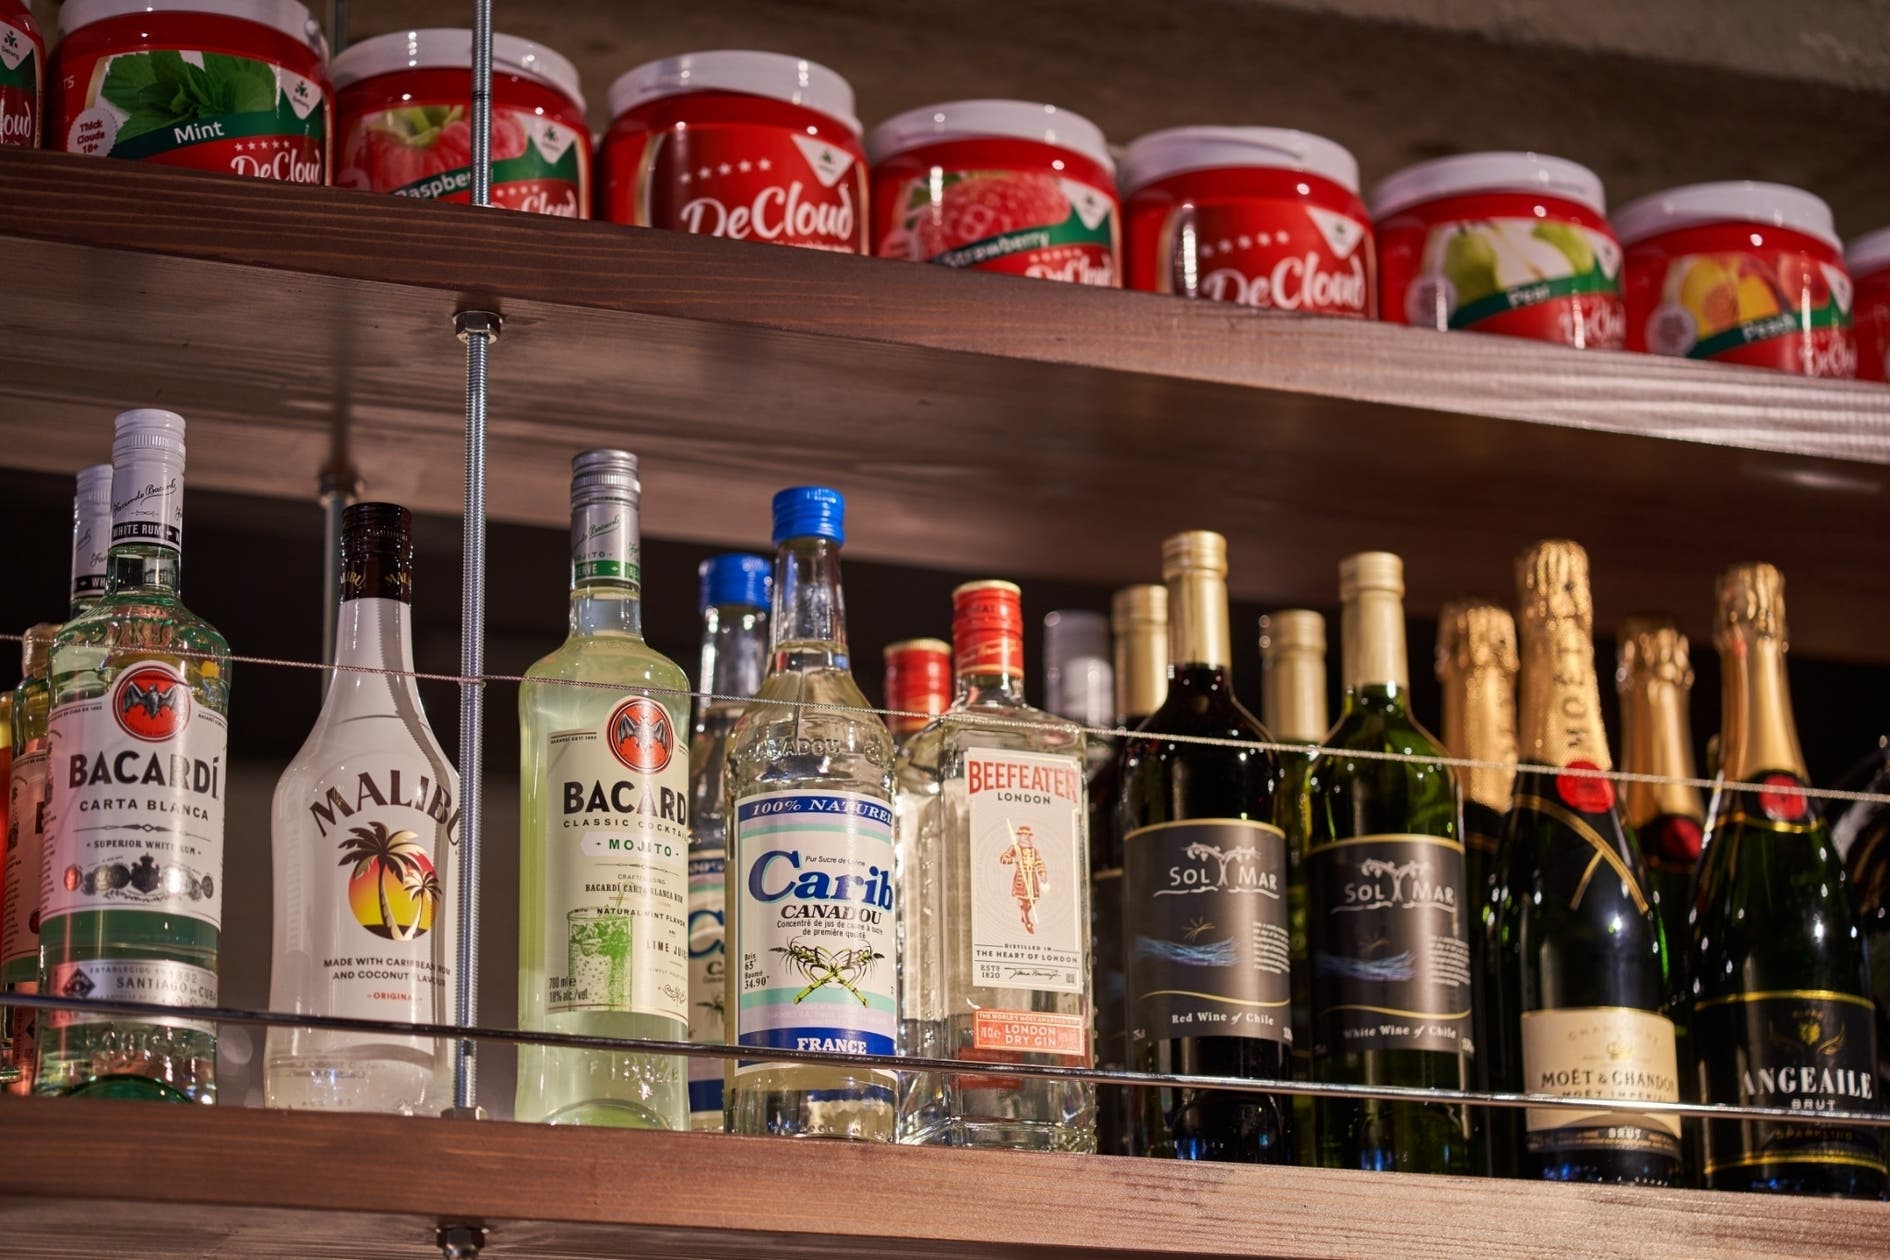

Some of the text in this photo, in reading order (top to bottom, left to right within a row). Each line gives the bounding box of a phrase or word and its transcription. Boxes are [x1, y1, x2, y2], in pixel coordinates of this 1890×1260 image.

[80, 121, 103, 132] Thick
[173, 120, 225, 145] Mint
[77, 131, 105, 145] Clouds
[82, 144, 98, 153] 18+
[230, 148, 322, 184] DeCloud
[680, 180, 854, 240] DeCloud
[943, 231, 1050, 267] Strawberry
[1201, 251, 1366, 310] DeCloud
[113, 524, 139, 537] WHITE
[69, 750, 219, 799] BACARDÍ
[968, 760, 1079, 804] BEEFEATER
[997, 792, 1052, 805] LONDON
[80, 798, 209, 821] CARTA BLANCA
[752, 799, 802, 816] 100%
[563, 818, 629, 829] CLASSIC
[94, 840, 142, 849] SUPERIOR
[146, 840, 175, 850] WHIT
[608, 838, 672, 857] MOJITO
[805, 855, 818, 864] Pur
[818, 855, 837, 864] Sucre
[837, 856, 846, 865] de
[748, 850, 893, 912] Carib
[1169, 866, 1278, 891] SOL MAR
[585, 881, 621, 893] BACARDÍ
[1345, 882, 1454, 905] SOL MAR
[597, 907, 641, 917] NATURAL
[780, 904, 882, 925] CANADOU
[777, 919, 812, 929] Concentré
[813, 919, 822, 928] de
[824, 920, 835, 929] jus
[836, 920, 845, 929] de
[802, 928, 811, 936] de
[813, 928, 844, 938] première
[647, 939, 670, 953] LIME
[323, 957, 353, 967] MADE
[356, 957, 383, 967] WITH
[996, 951, 1024, 960] HEART
[1041, 954, 1078, 964] LONDON
[332, 970, 446, 987] AND COCONUT LAVOUR
[981, 971, 1001, 979] 1820
[116, 976, 188, 992] SANTIAGO
[1172, 1012, 1274, 1026] Red Wine of Chile
[1005, 1024, 1057, 1036] LONDON
[1380, 1025, 1410, 1036] Wine
[1413, 1024, 1425, 1038] of
[1428, 1025, 1457, 1039] Chile
[796, 1038, 868, 1054] FRANCE
[1005, 1034, 1030, 1045] DRY
[1034, 1036, 1057, 1047] GIN
[1540, 1069, 1674, 1093] MOËT & CHANDON
[1743, 1066, 1873, 1100] ANGEAILE
[1791, 1098, 1836, 1112] BRUT
